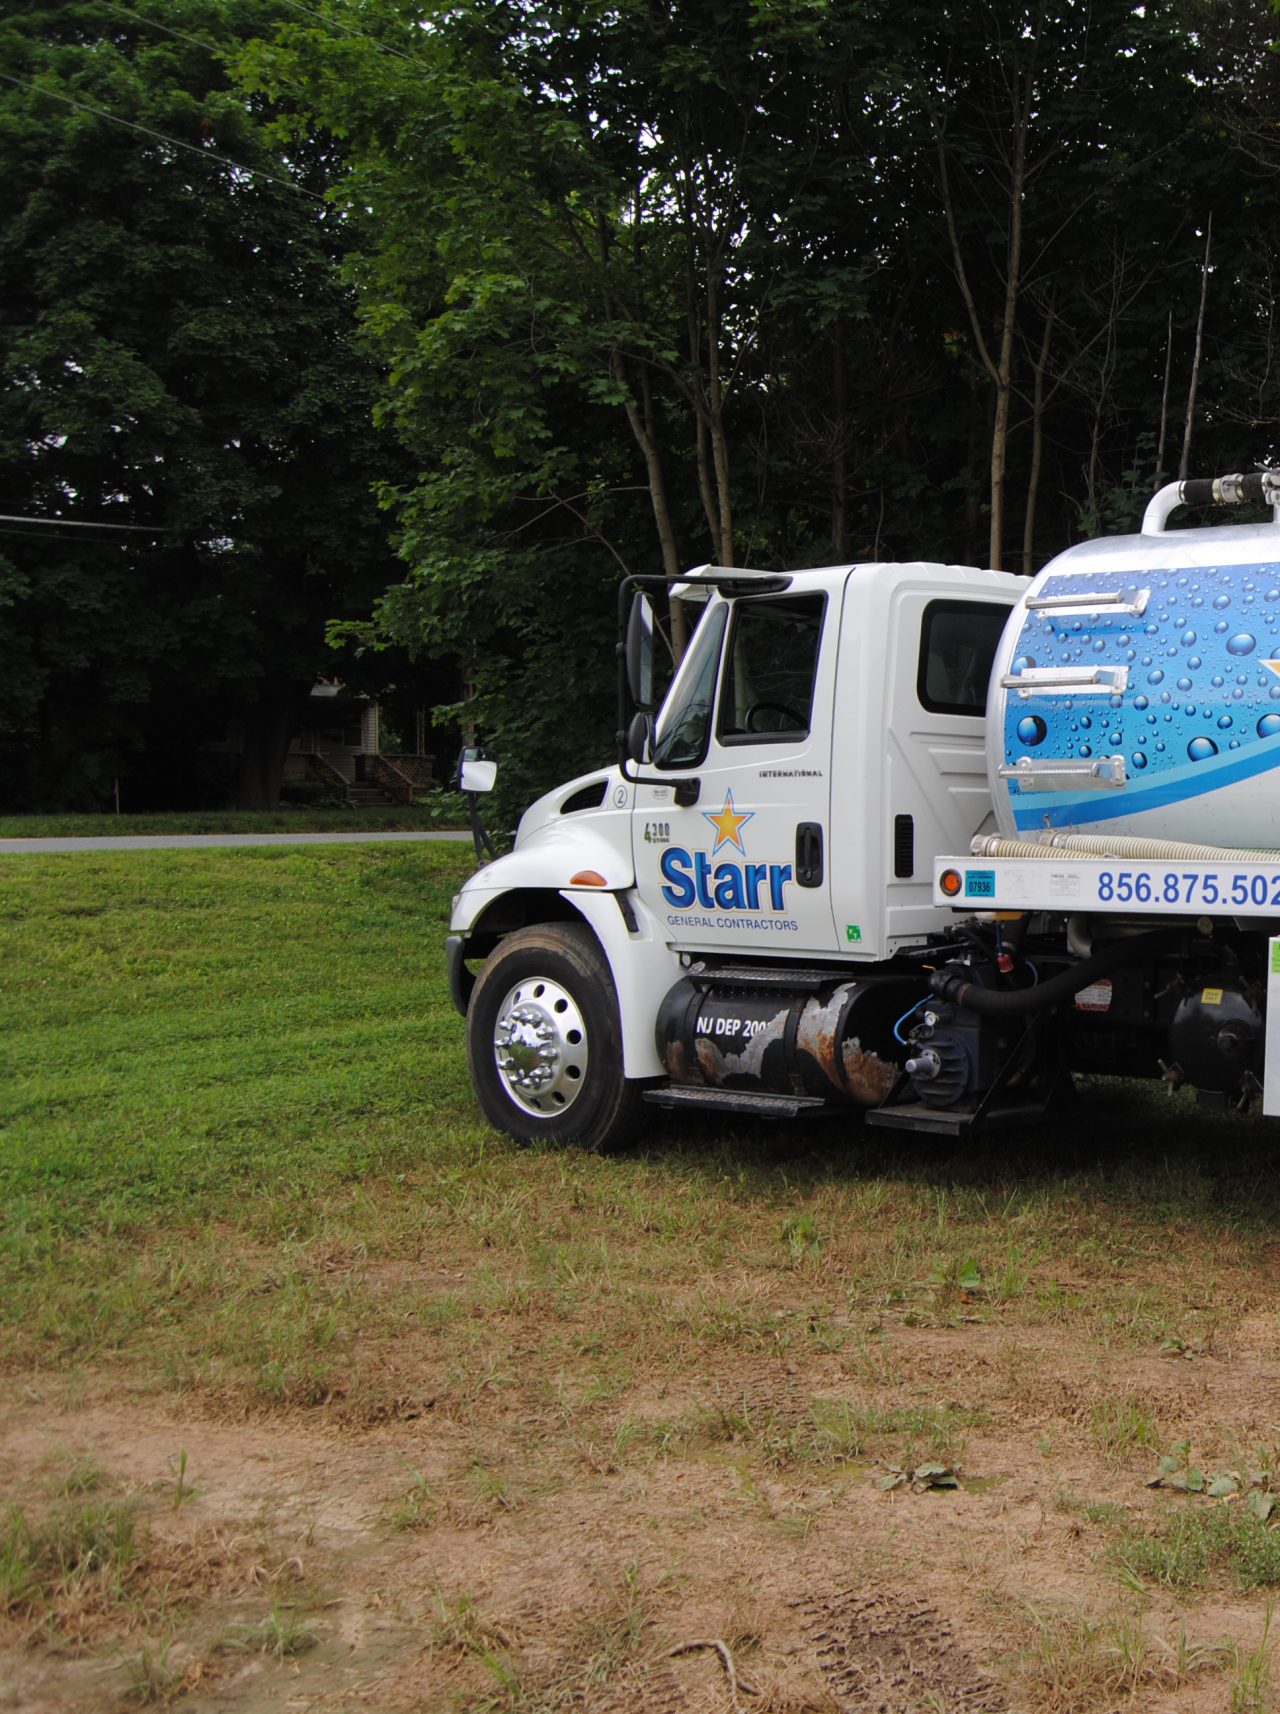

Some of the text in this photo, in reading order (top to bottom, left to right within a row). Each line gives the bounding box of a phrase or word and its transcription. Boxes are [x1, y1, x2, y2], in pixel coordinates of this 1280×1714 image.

[759, 769, 823, 778] INTERNATIONAL
[617, 790, 624, 804] 2
[644, 822, 670, 843] 4300
[659, 845, 794, 912] Starr
[968, 881, 991, 893] 07936
[667, 915, 799, 931] GENERAL CONTRACTORS
[696, 1016, 772, 1037] NJ DEP 200
